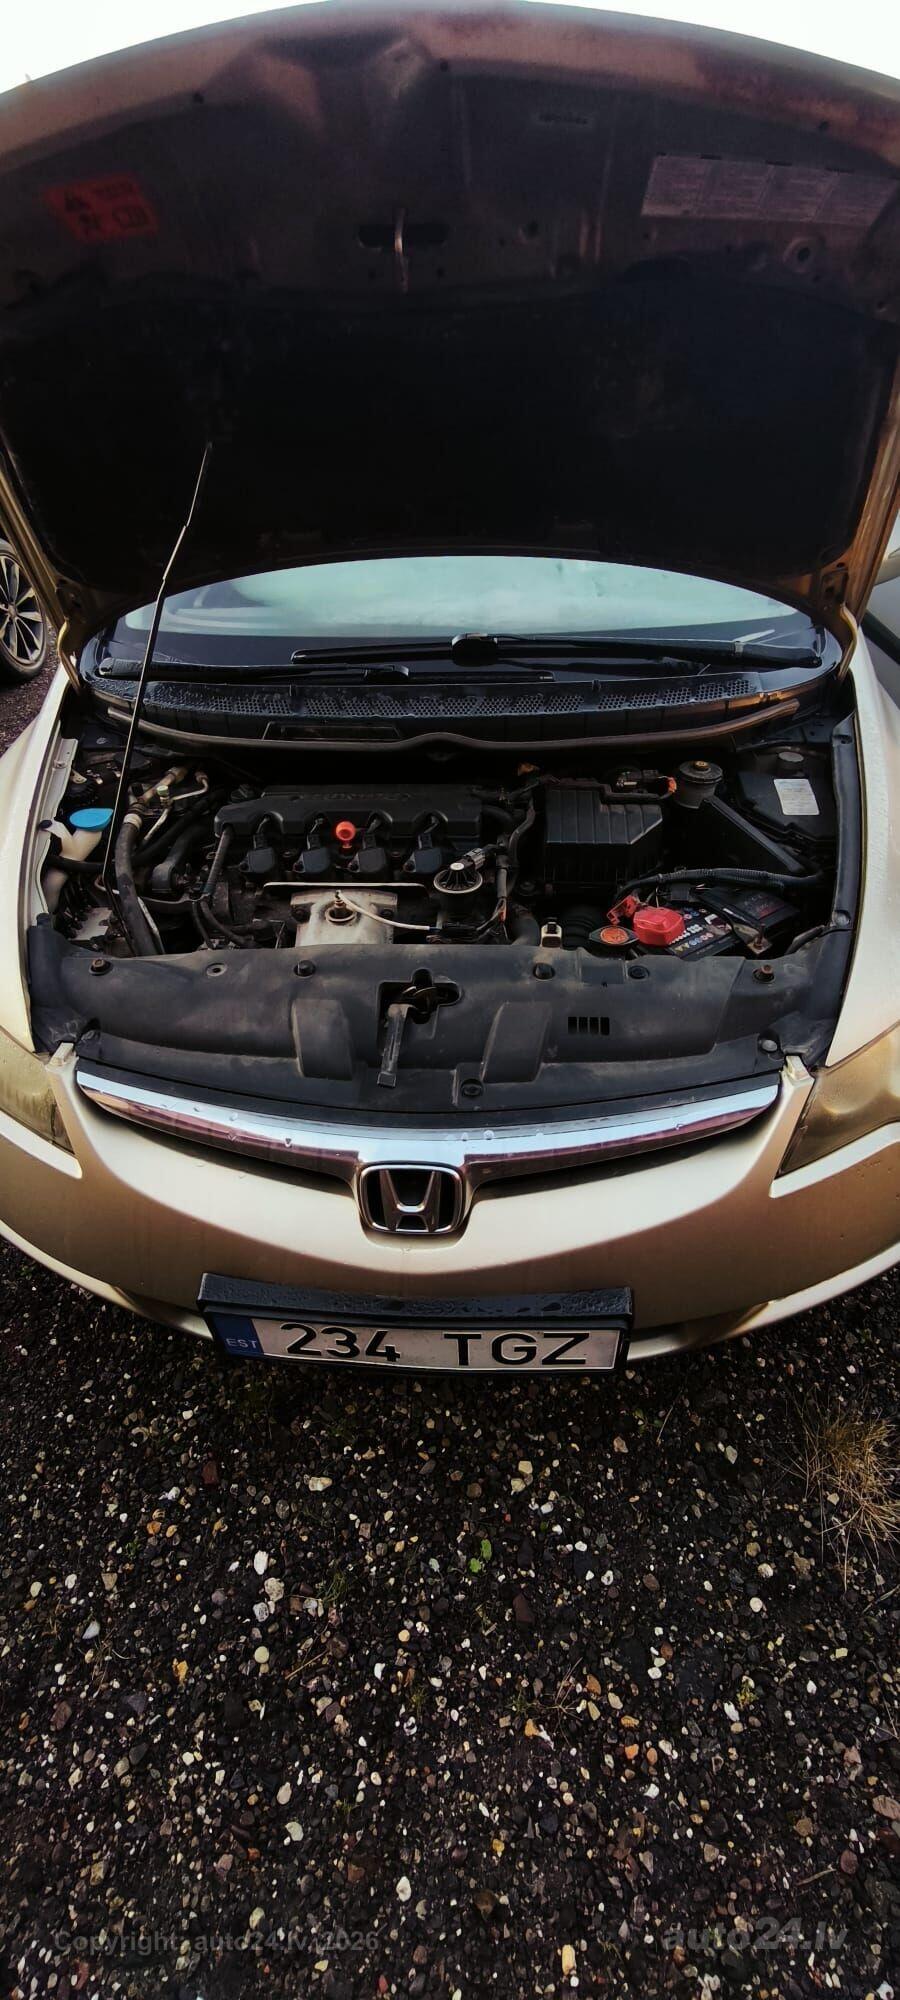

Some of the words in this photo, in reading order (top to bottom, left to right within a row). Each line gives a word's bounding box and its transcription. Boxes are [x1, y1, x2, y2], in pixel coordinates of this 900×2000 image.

[226, 1337, 258, 1350] EST
[279, 1323, 402, 1363] 234
[443, 1332, 591, 1366] TGZ
